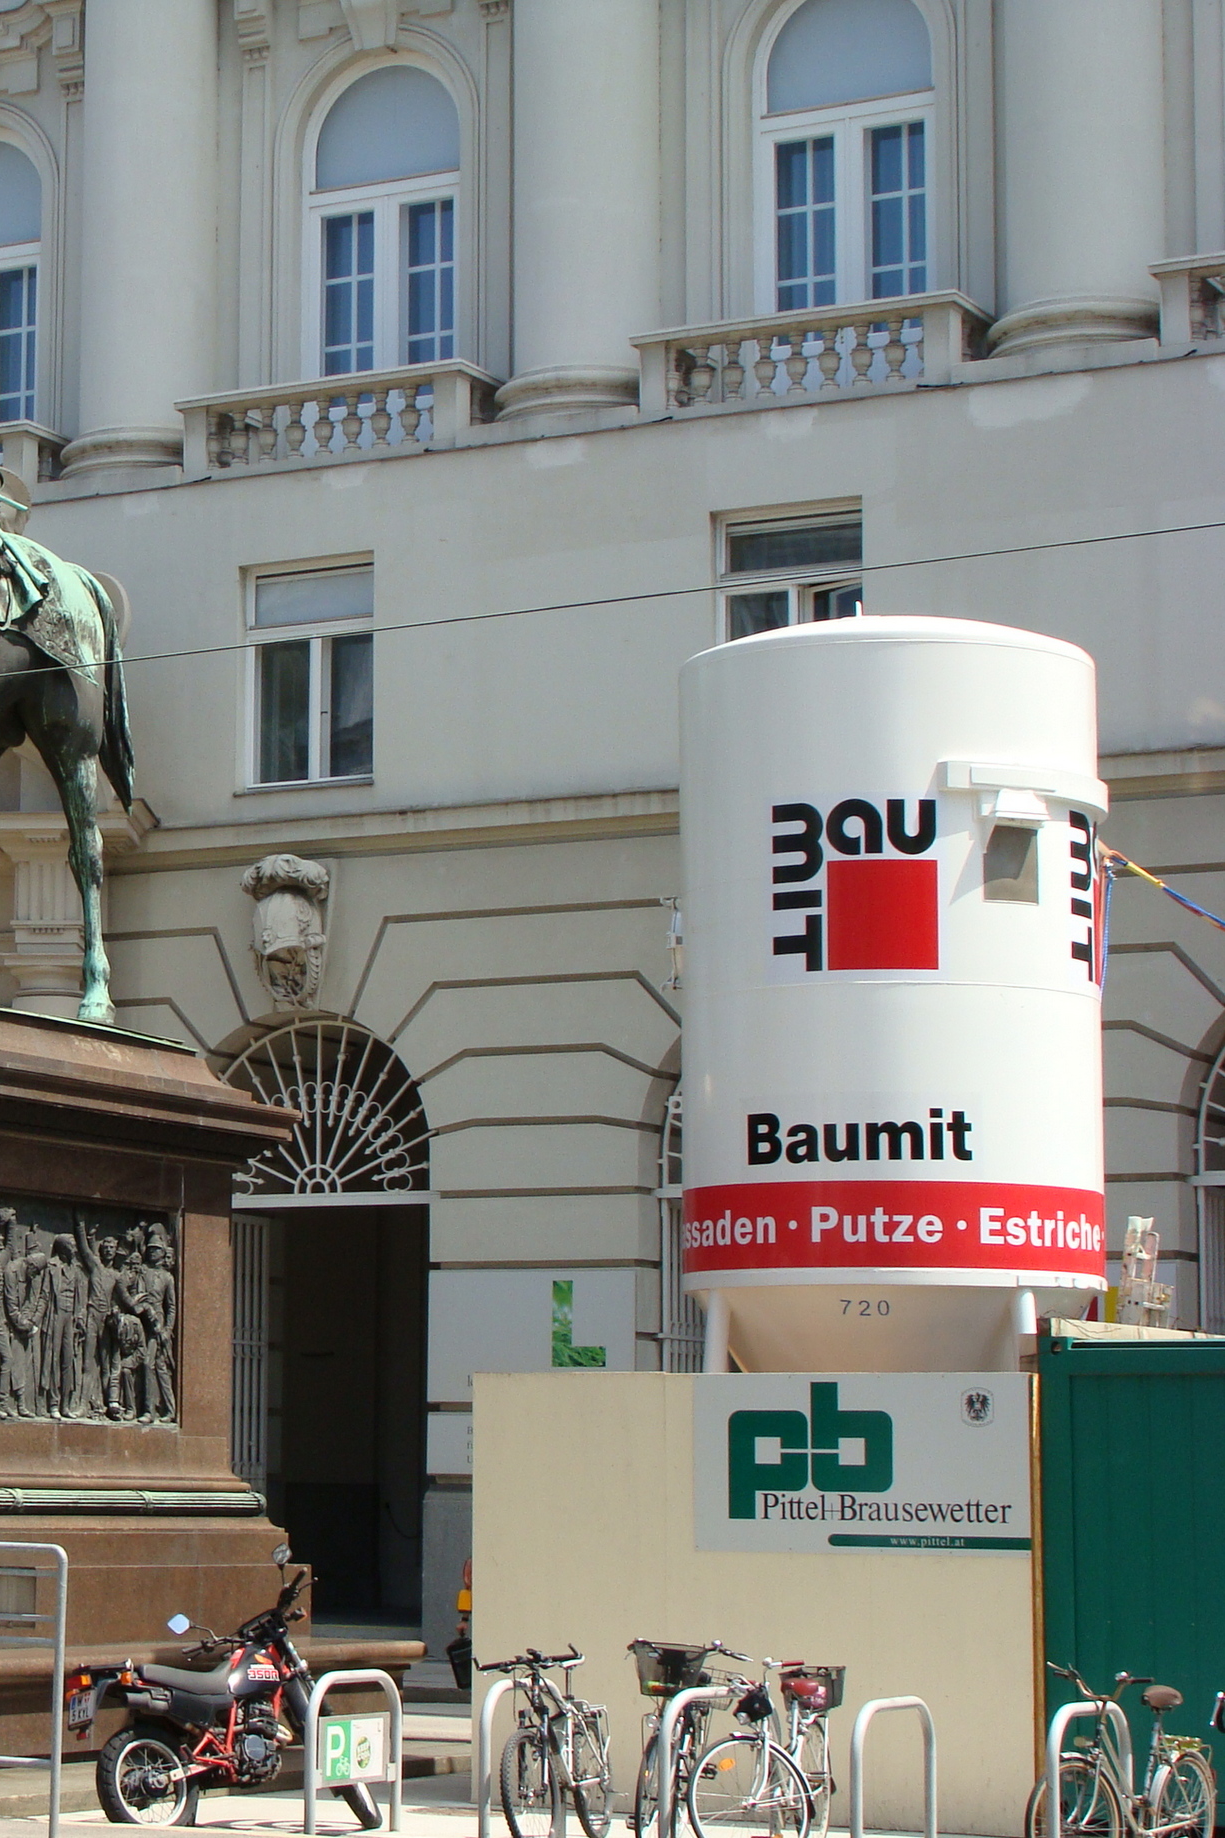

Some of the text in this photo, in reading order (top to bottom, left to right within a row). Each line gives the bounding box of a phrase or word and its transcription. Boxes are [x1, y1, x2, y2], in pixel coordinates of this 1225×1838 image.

[747, 1108, 973, 1165] Baumit
[682, 1206, 1101, 1252] ssaden Putze Estriche
[839, 1299, 891, 1317] 720
[890, 1536, 965, 1549] www.pittel.at
[326, 1725, 346, 1777] P
